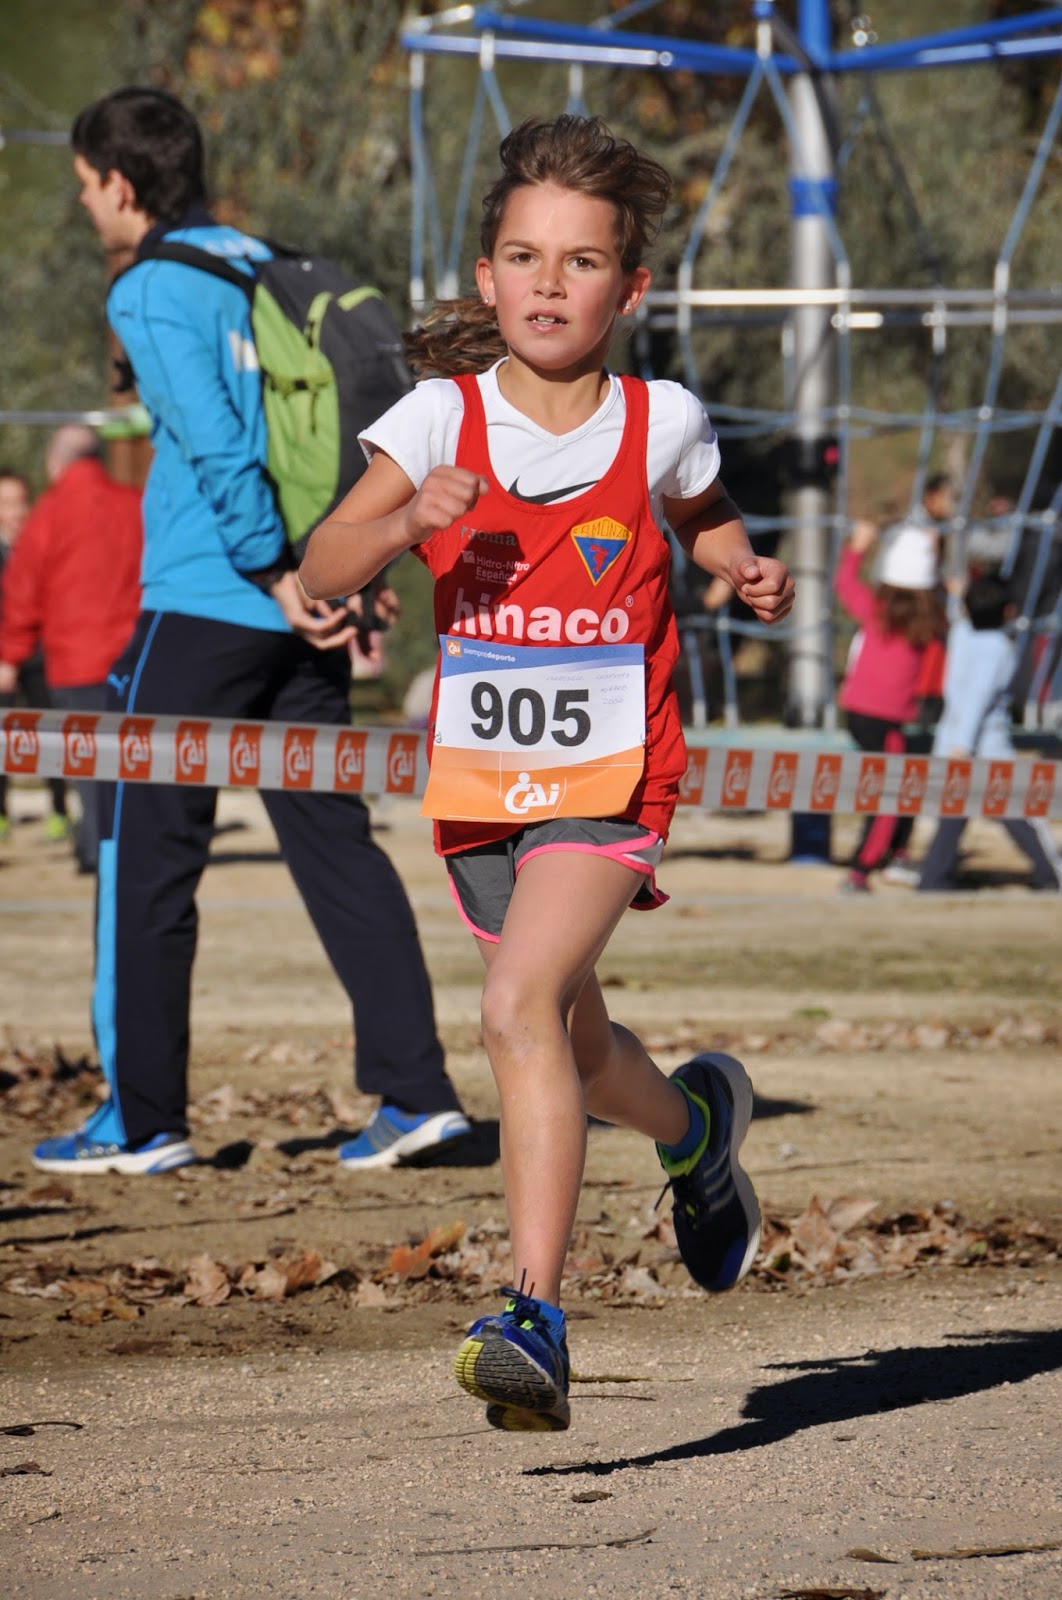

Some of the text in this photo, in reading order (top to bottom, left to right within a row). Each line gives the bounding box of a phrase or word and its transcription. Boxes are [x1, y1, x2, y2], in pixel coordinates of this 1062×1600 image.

[476, 555, 531, 572] Hidro-Nitro
[476, 566, 518, 582] Española
[452, 587, 630, 644] hinaco
[470, 681, 592, 747] 905
